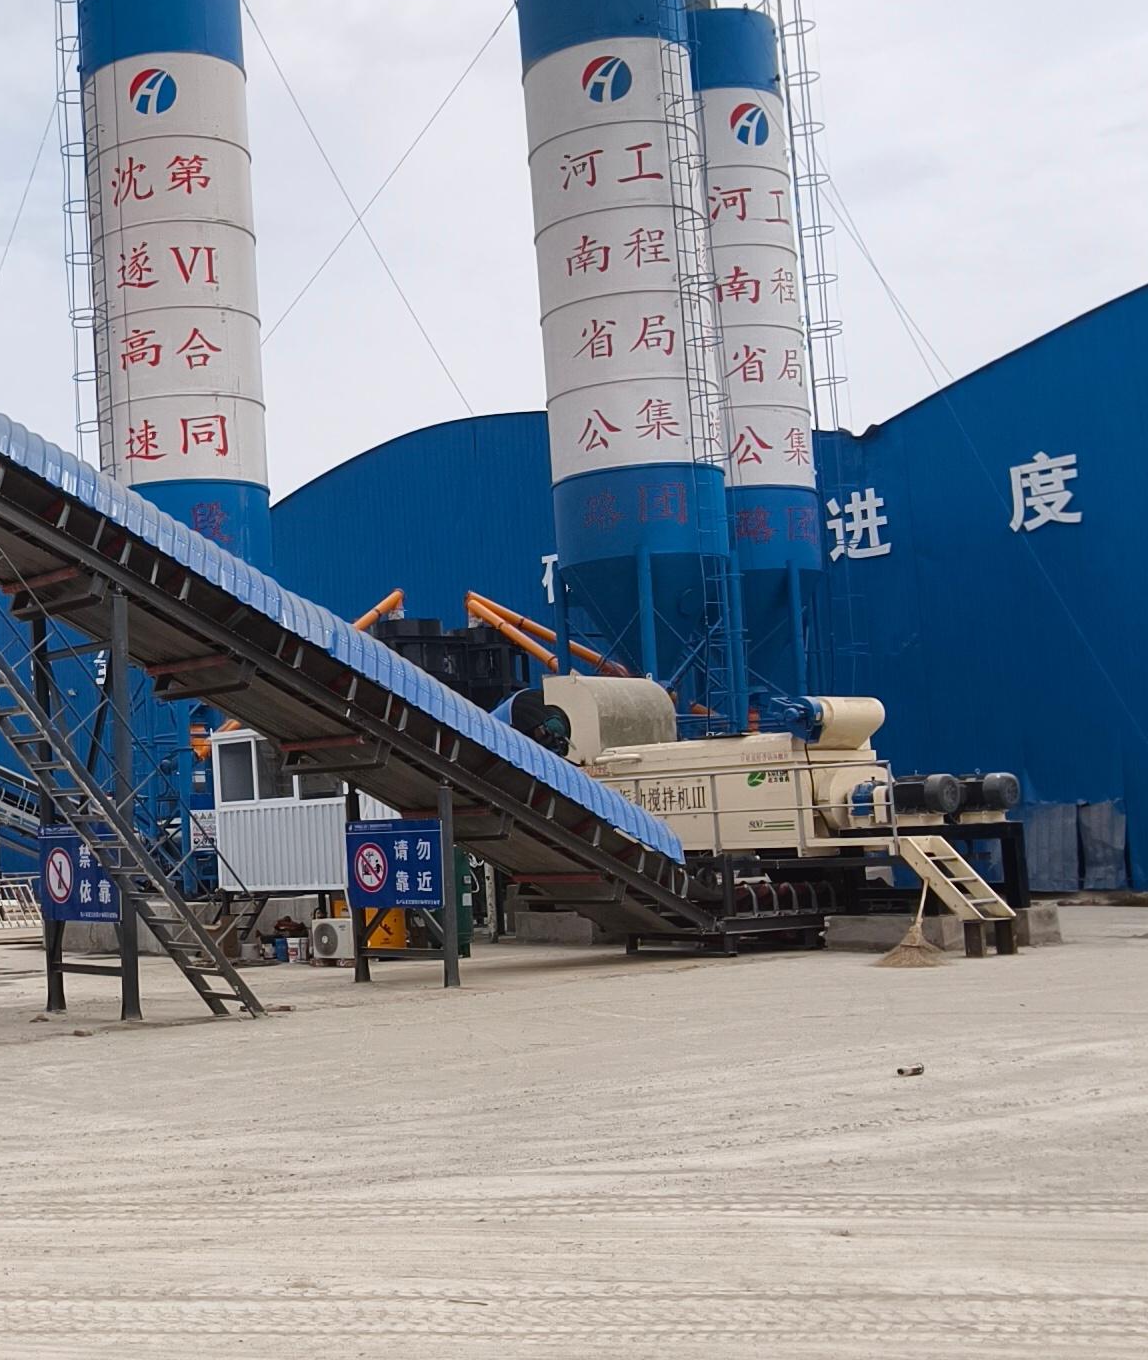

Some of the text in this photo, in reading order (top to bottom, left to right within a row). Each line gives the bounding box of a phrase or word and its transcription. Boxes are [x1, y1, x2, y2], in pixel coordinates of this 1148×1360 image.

[111, 157, 167, 461] 沈遂高速
[394, 839, 431, 861] 请勿
[396, 871, 432, 892] 靠近
